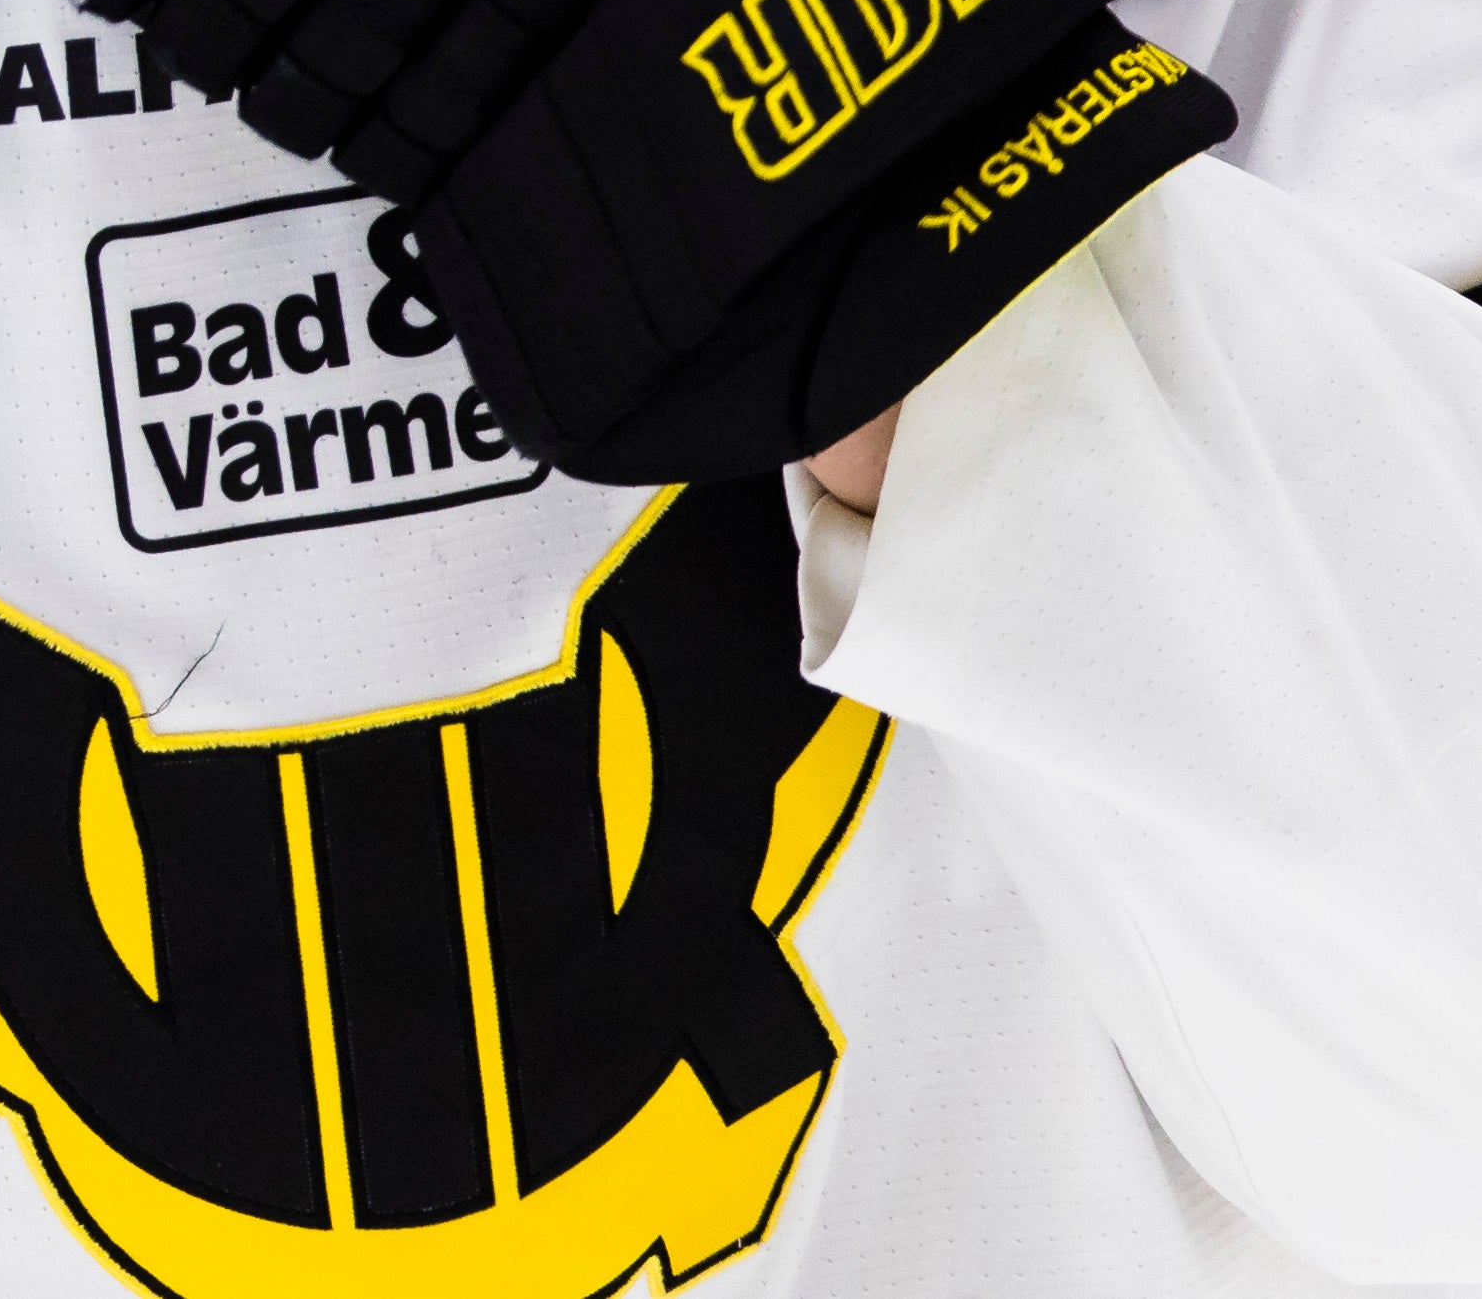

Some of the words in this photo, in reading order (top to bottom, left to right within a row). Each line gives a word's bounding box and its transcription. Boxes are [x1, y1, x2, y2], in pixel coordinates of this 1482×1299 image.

[917, 185, 994, 254] IK
[130, 272, 351, 399] Bad
[141, 382, 515, 511] Värme
